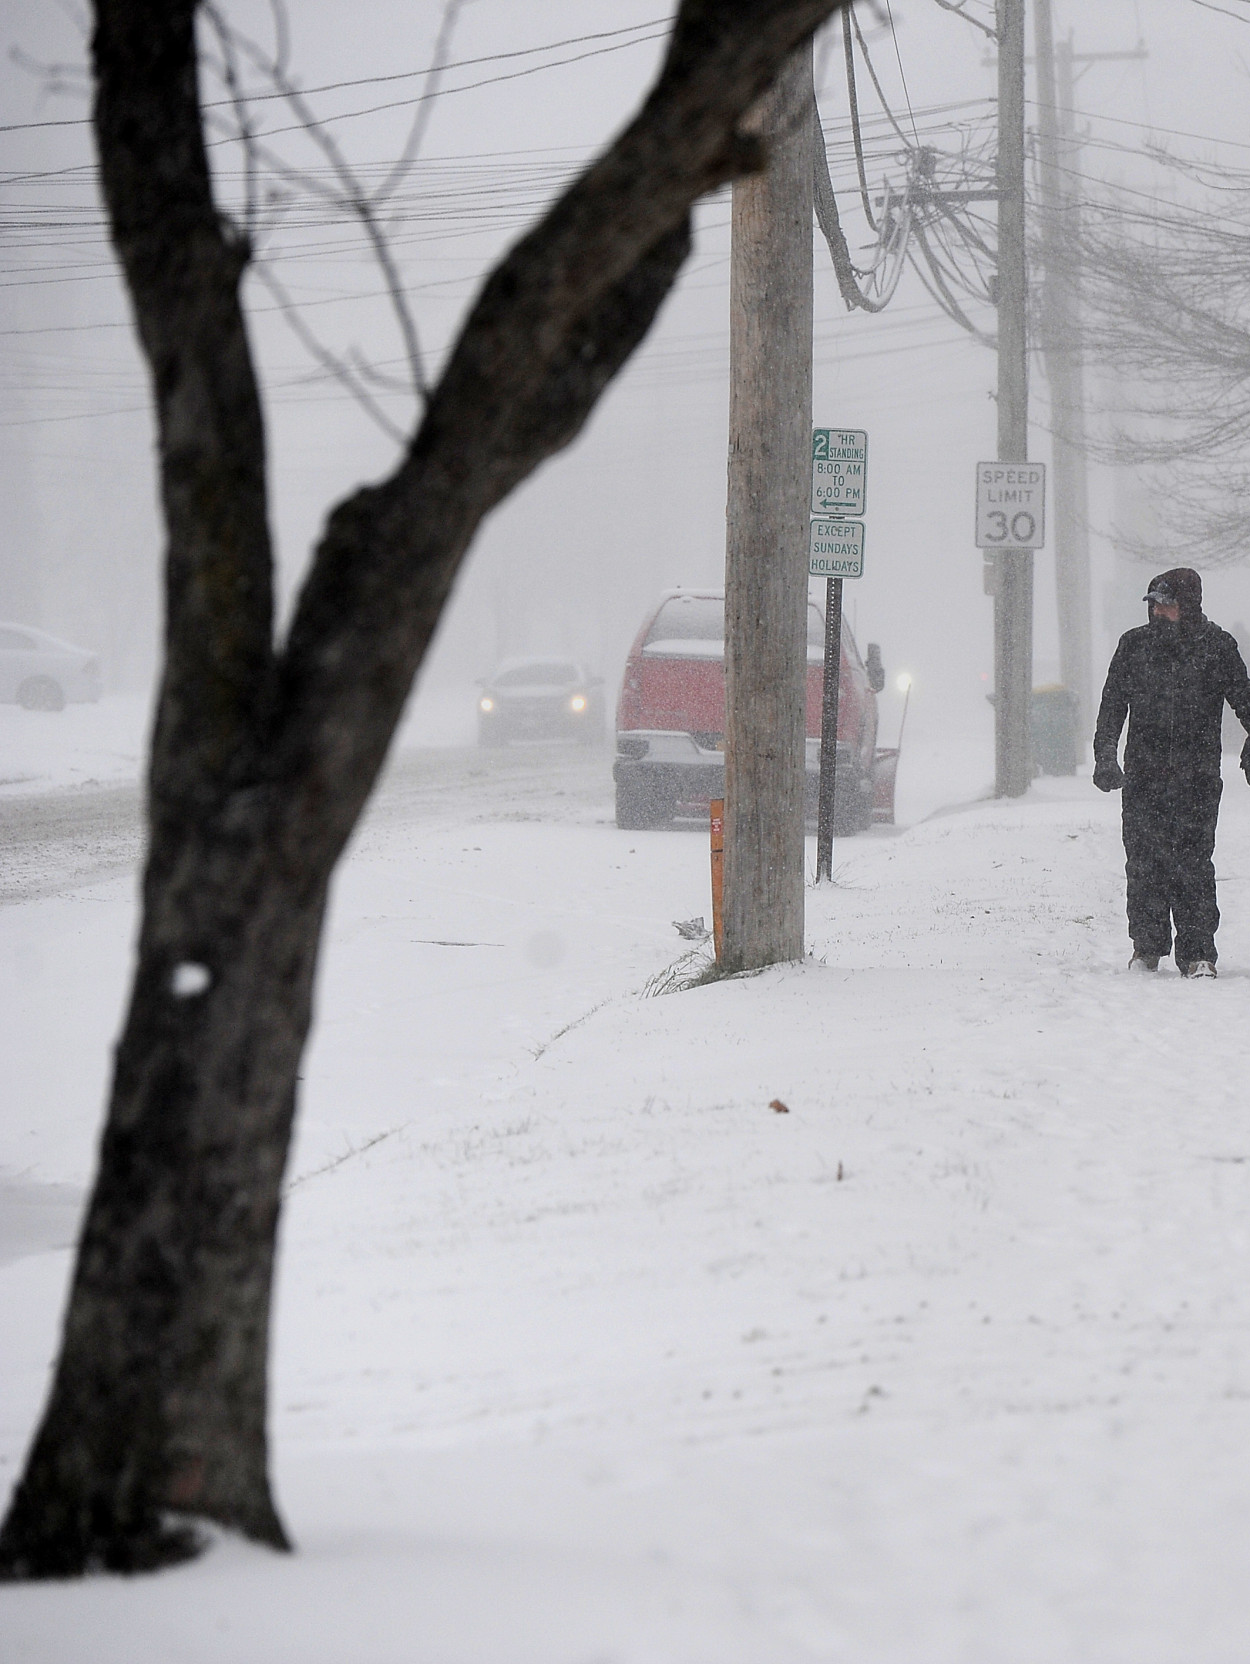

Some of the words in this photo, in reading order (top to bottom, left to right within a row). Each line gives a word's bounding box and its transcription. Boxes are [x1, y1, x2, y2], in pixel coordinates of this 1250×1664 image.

[814, 434, 827, 456] 2
[830, 447, 864, 460] STANDING
[817, 463, 841, 474] 8:00
[846, 464, 861, 475] AM
[832, 475, 845, 486] TO
[983, 470, 1040, 484] SPEED
[816, 486, 840, 498] 6:00
[845, 488, 860, 499] PM
[987, 489, 1034, 502] LIMIT
[817, 525, 856, 538] EXCEPT
[985, 510, 1036, 543] 30
[813, 542, 859, 555] SUNDAYS
[811, 559, 859, 572] HOLIDAYS
